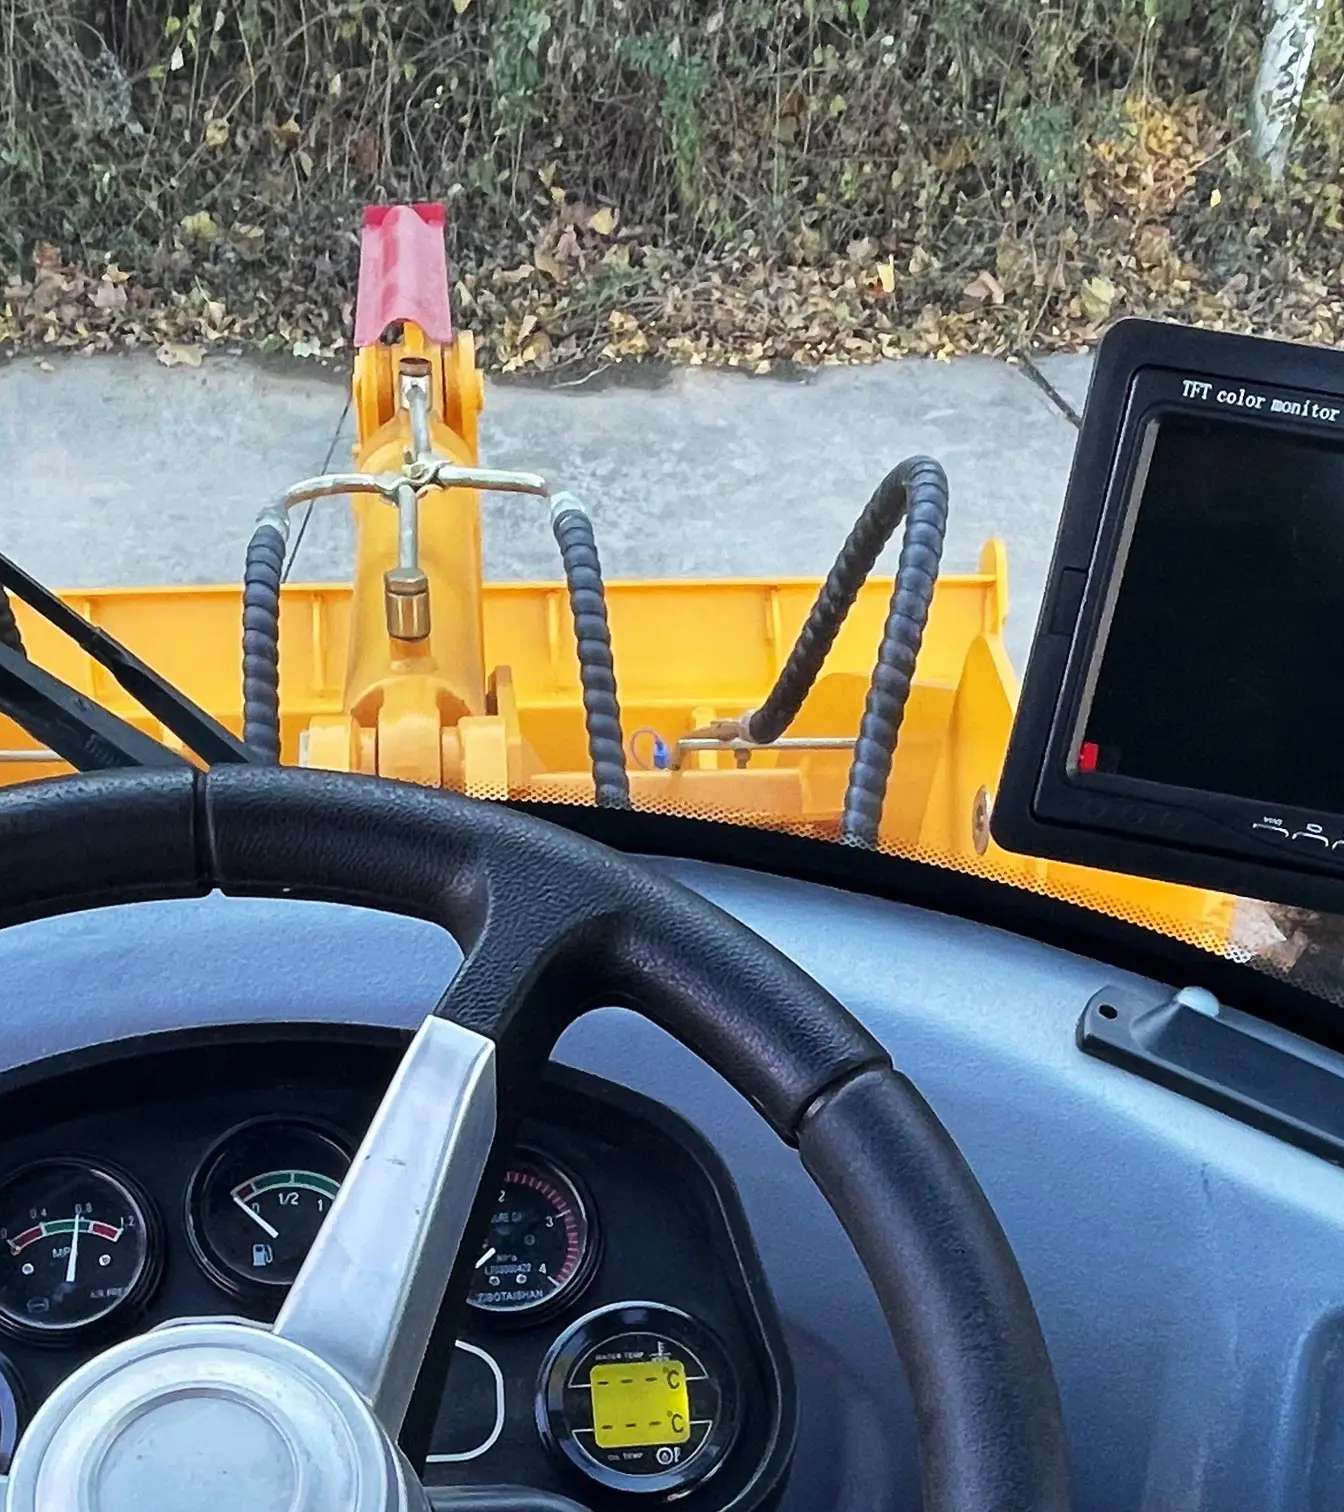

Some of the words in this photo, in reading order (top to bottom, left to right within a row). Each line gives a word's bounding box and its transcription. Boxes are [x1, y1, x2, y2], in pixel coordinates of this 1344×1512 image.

[1182, 379, 1213, 400] TFT
[1216, 388, 1266, 410] color
[1270, 398, 1341, 422] monitor
[278, 1192, 300, 1206] 1/2
[317, 1198, 324, 1212] 1
[545, 1215, 554, 1228] 3
[538, 1263, 547, 1275] 4
